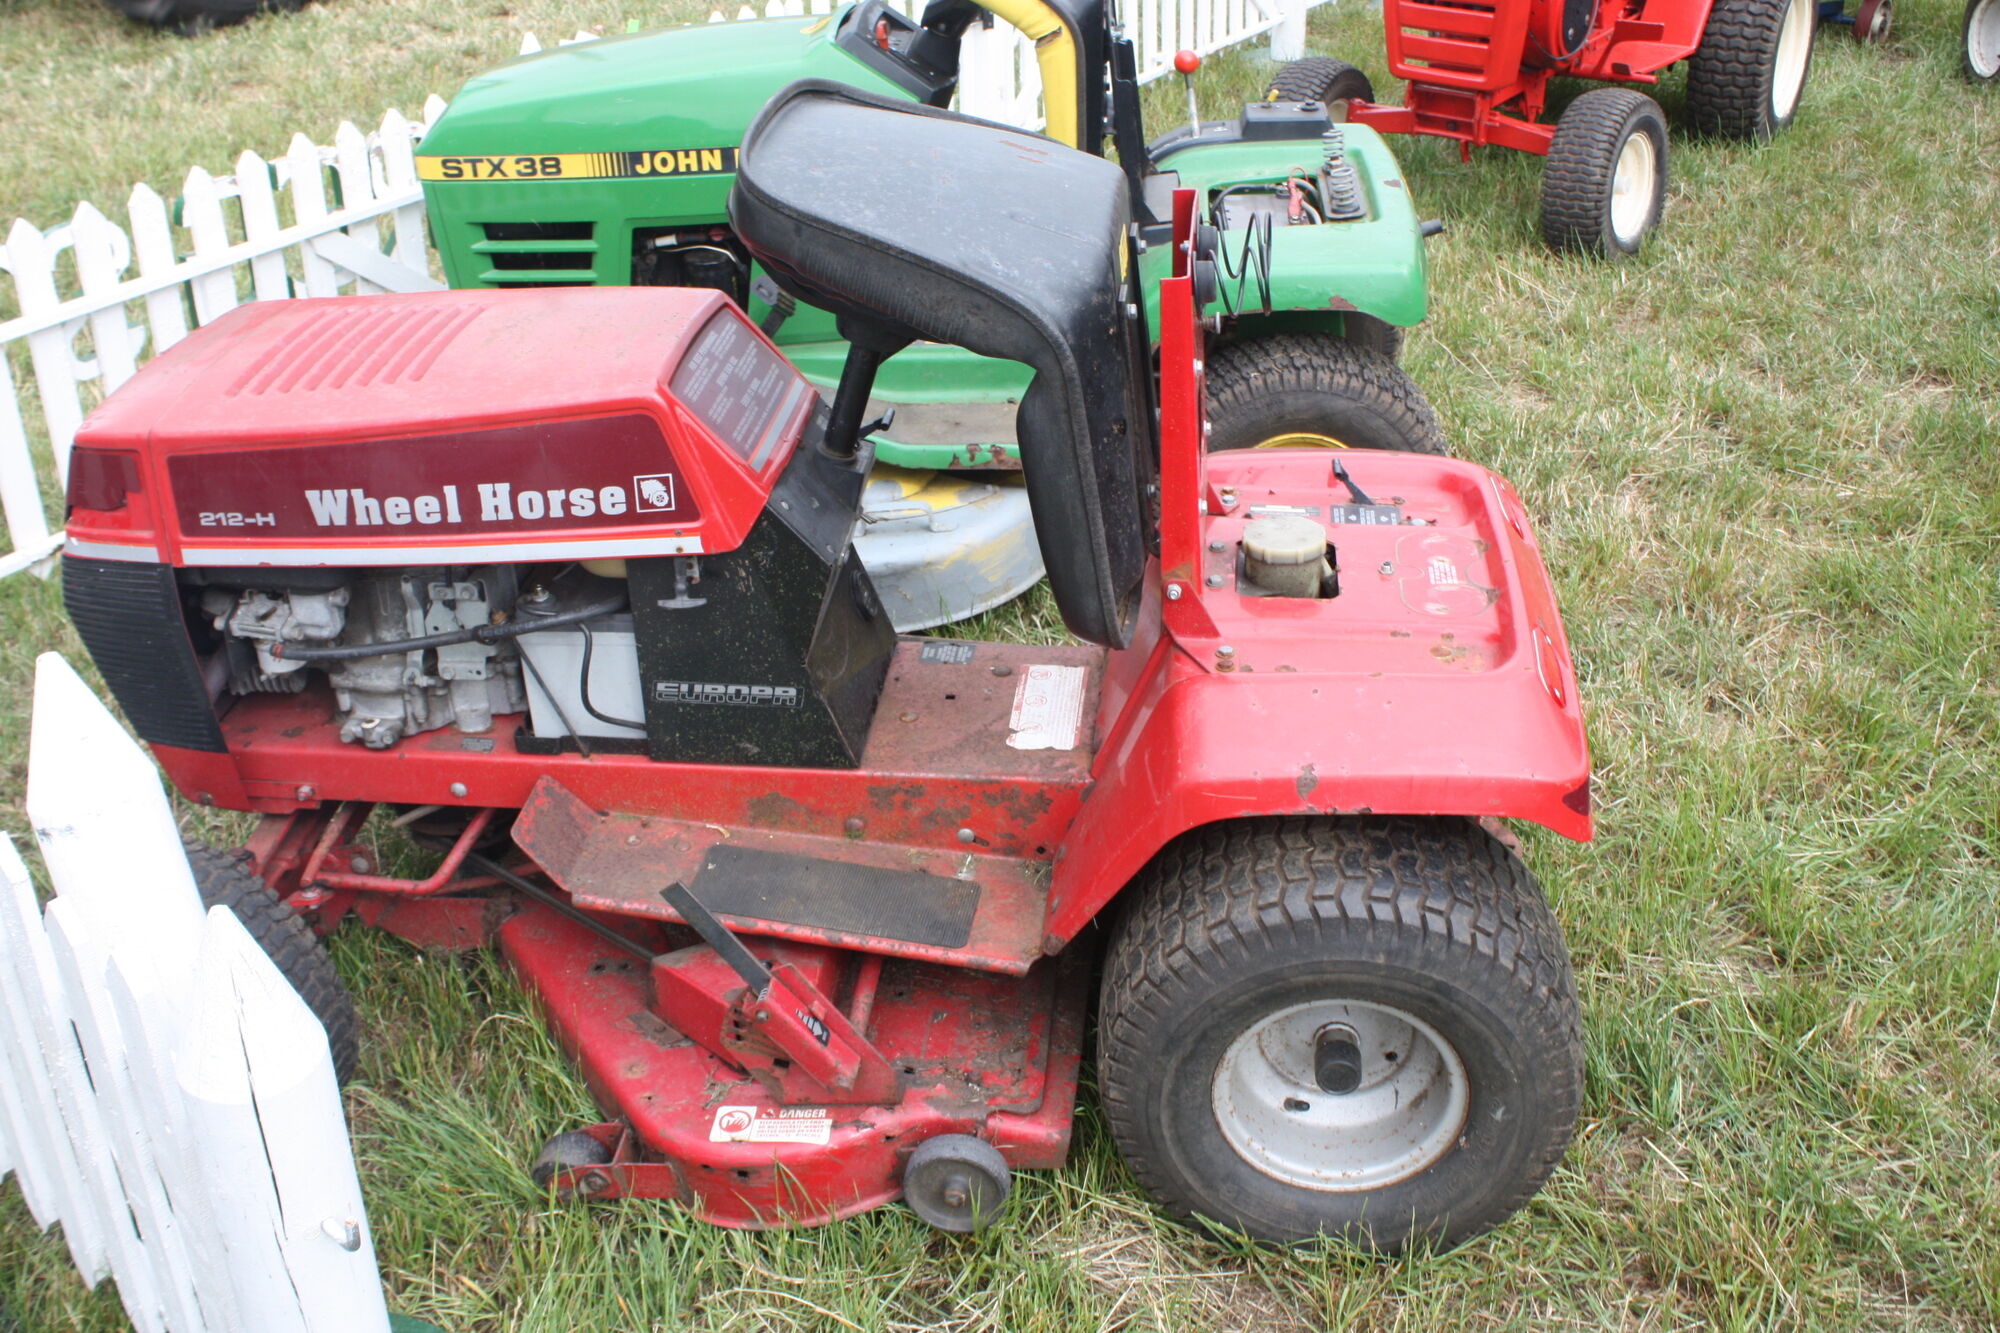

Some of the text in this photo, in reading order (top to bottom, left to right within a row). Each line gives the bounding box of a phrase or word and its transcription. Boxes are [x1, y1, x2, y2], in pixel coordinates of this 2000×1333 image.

[441, 157, 562, 178] STX 38
[635, 149, 722, 174] JOHN
[305, 482, 627, 527] Wheel Horse
[199, 512, 276, 526] 212-H
[655, 682, 797, 705] EUROPA
[779, 1108, 827, 1118] DANGER
